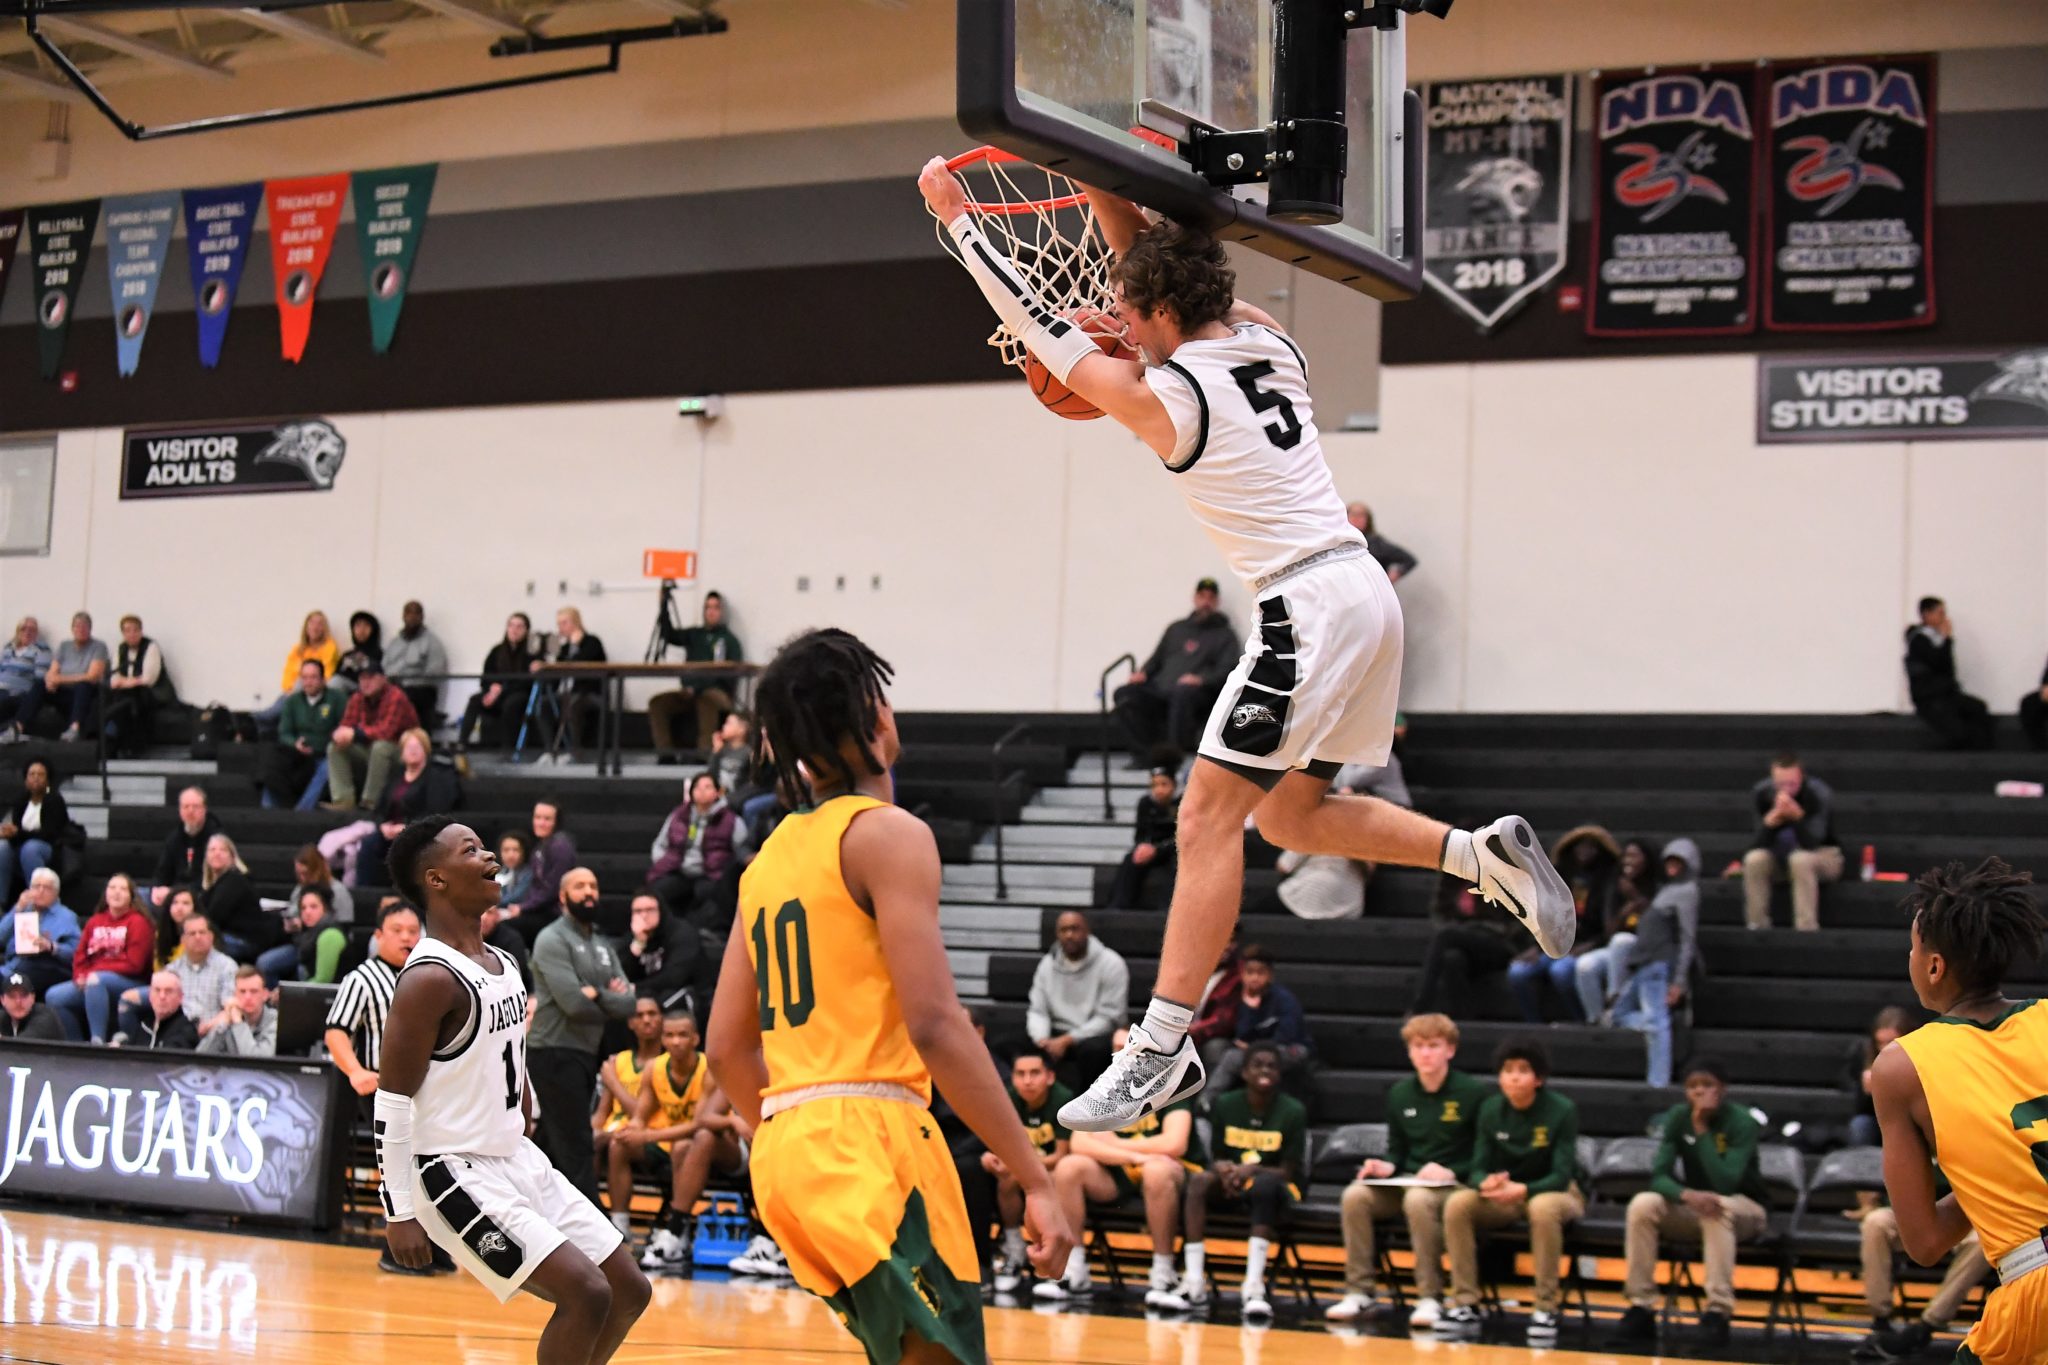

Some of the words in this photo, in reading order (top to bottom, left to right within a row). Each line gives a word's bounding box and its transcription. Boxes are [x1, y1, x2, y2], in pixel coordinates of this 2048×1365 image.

[1440, 81, 1553, 105] NATIONAL
[1599, 75, 1753, 140] NDA
[1771, 64, 1926, 128] NDA
[1429, 96, 1567, 126] CHAMPIONS
[1454, 258, 1526, 289] 2018
[1797, 367, 1942, 397] VISITOR
[1229, 359, 1302, 451] 5
[1771, 396, 1968, 428] STUDENTS
[147, 437, 238, 462] VISITOR
[145, 460, 236, 486] ADULTS
[752, 897, 816, 1031] 10
[0, 1066, 267, 1184] JAGUARS
